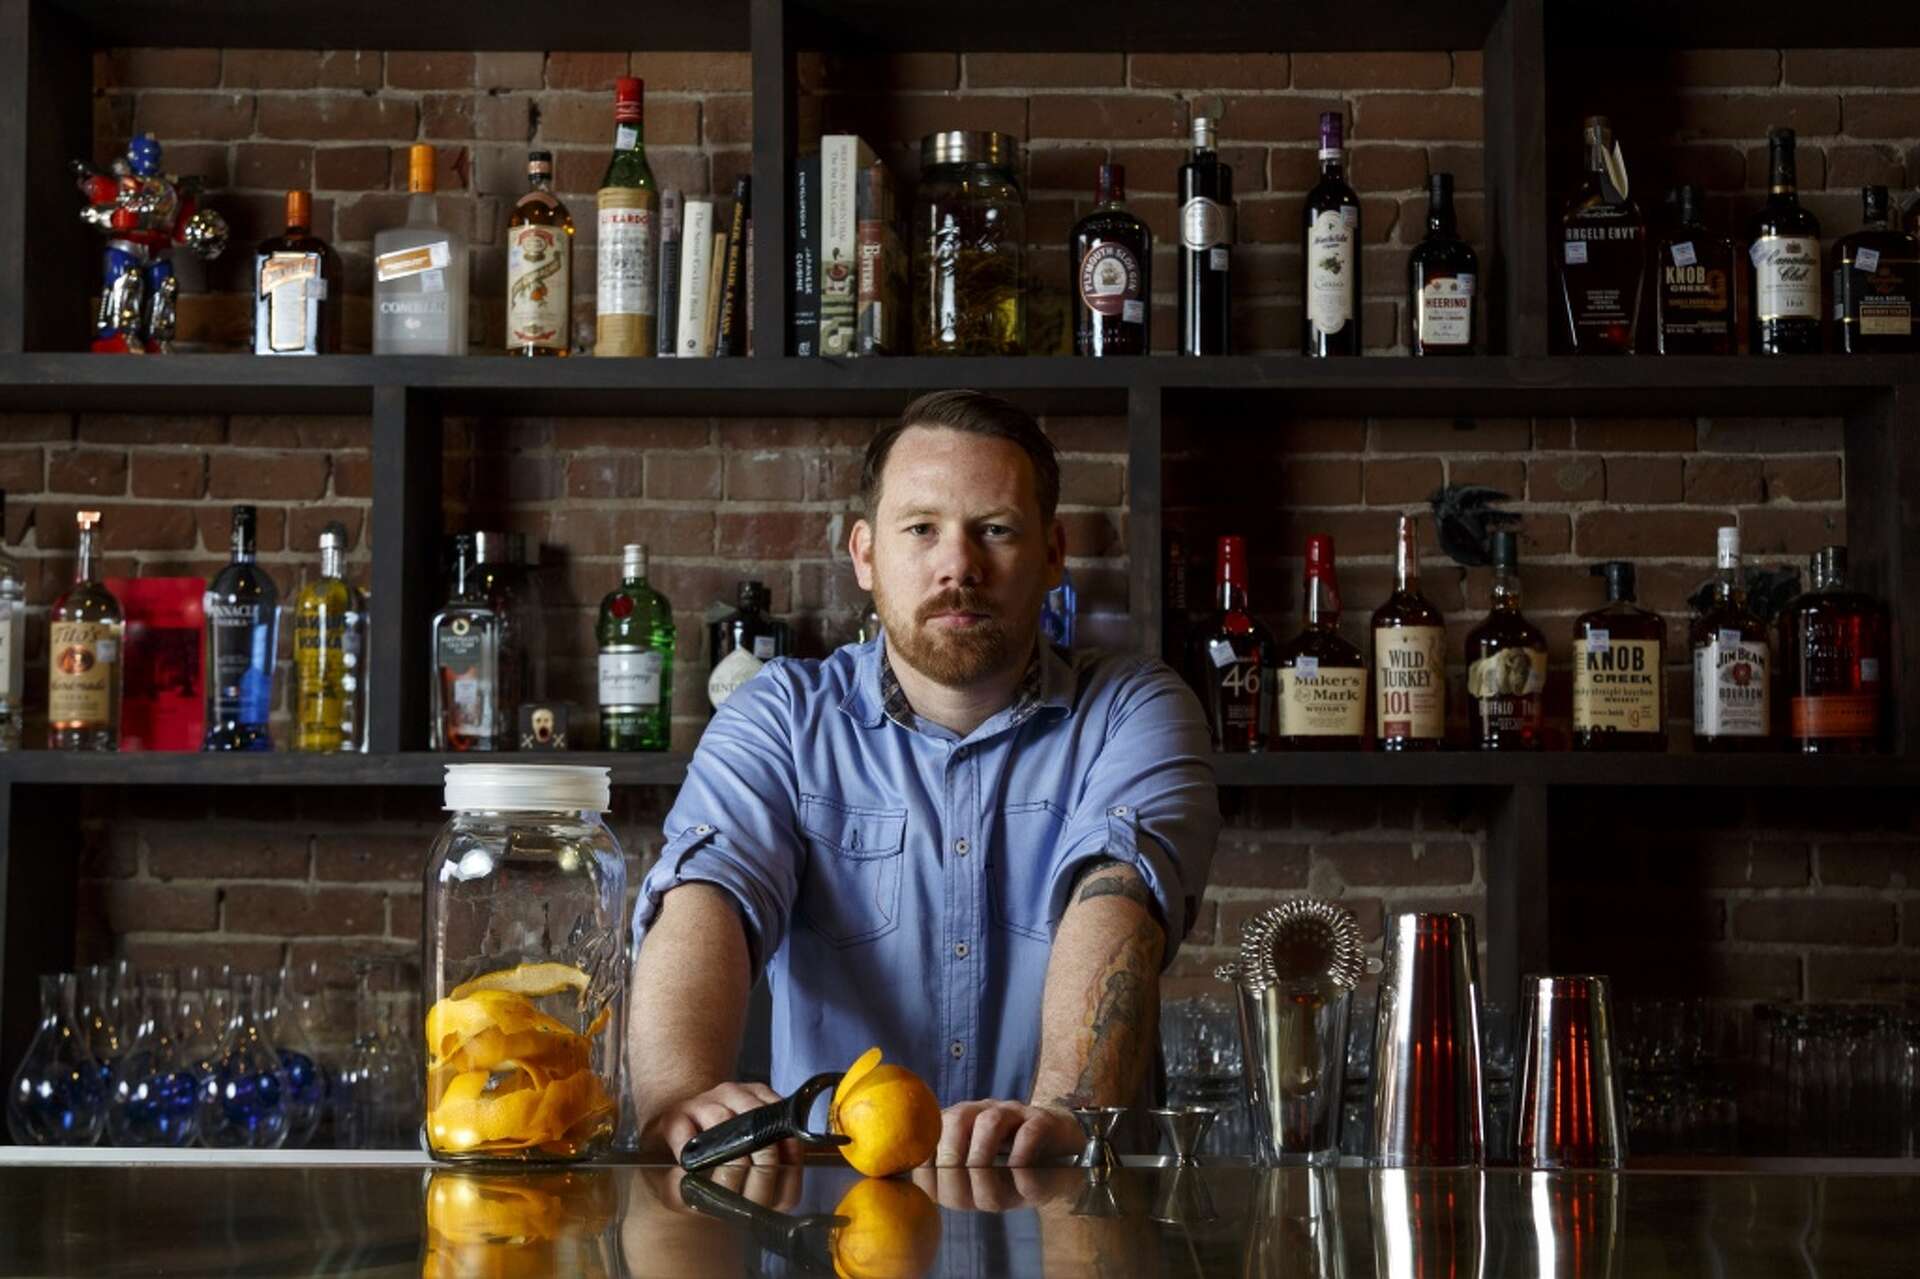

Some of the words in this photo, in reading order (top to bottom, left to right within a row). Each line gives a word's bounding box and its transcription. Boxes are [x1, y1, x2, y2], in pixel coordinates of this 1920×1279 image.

[798, 171, 809, 228] ENCYCLOPEDIA
[795, 253, 804, 292] CUISINE
[804, 248, 814, 295] JAPANESE
[1082, 246, 1114, 293] PLYMOUTH
[1666, 265, 1705, 284] KNOB
[1778, 266, 1809, 282] Club
[1388, 649, 1425, 668] WILD
[1587, 646, 1645, 671] KNOB
[1715, 651, 1737, 670] JIM
[1221, 665, 1260, 697] 46
[1295, 675, 1360, 687] Maker's
[1381, 668, 1431, 688] TURKEY
[1592, 673, 1653, 685] CREEK
[1312, 689, 1360, 702] Mark
[1383, 691, 1412, 715] 101
